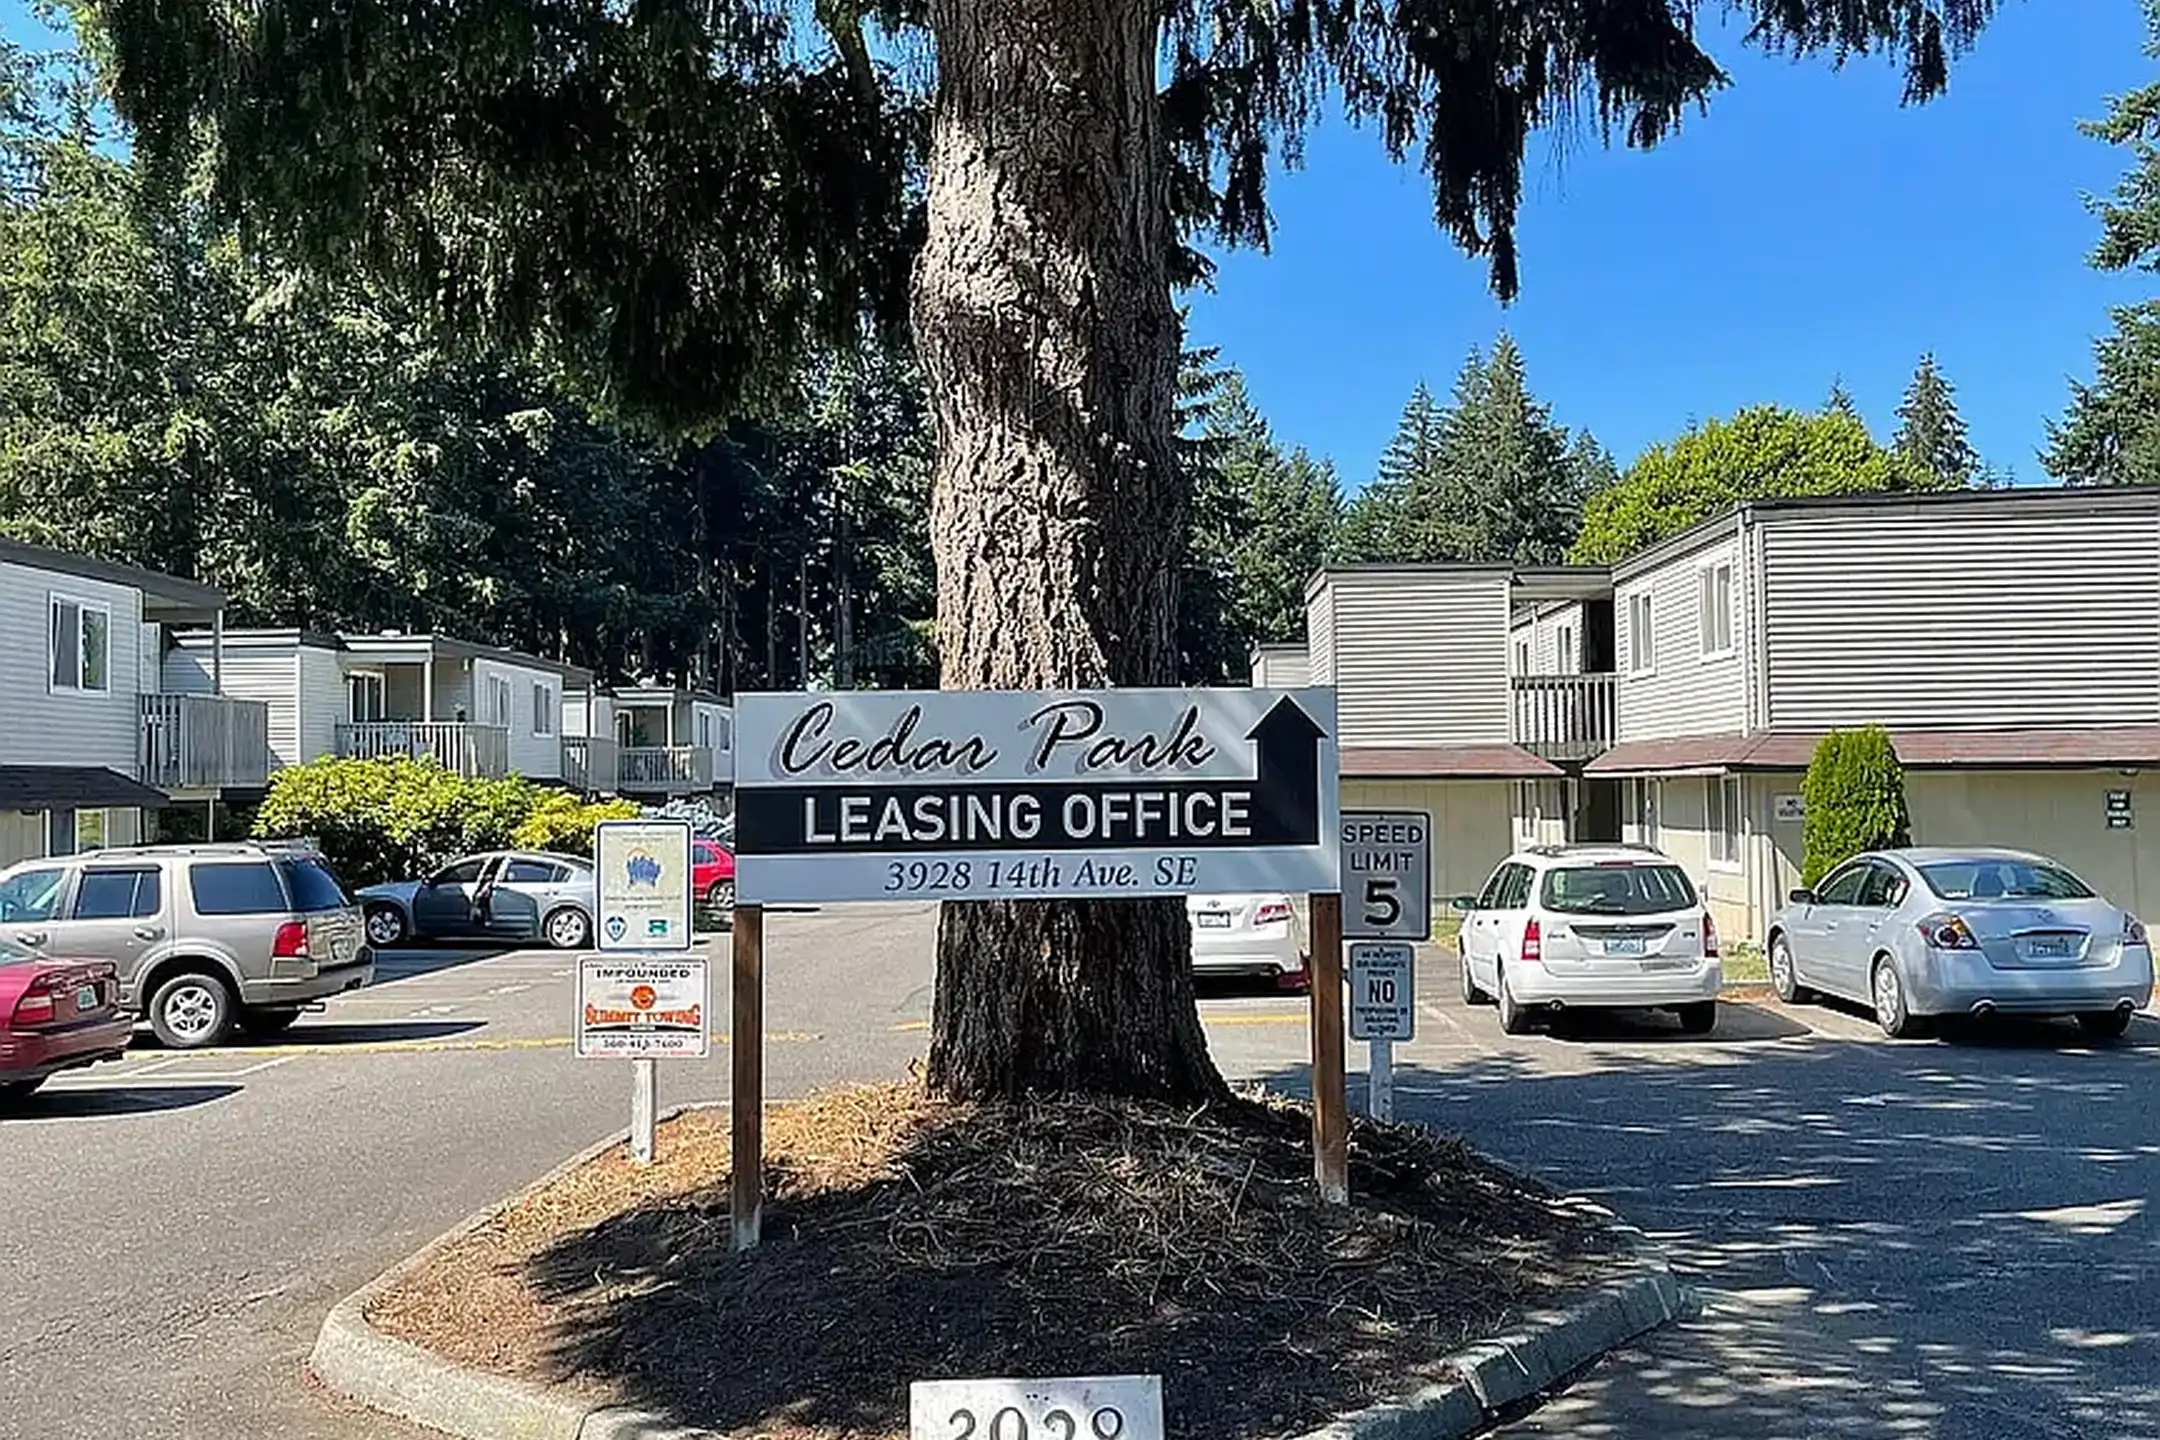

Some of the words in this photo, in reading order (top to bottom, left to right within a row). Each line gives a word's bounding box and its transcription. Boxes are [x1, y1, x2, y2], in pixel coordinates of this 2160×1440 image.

[773, 699, 998, 777] Cedar
[1021, 699, 1216, 773] Park
[805, 793, 1042, 843] LEASING
[1062, 791, 1252, 839] OFFICE
[1342, 824, 1424, 844] SPEED
[884, 860, 972, 892] 3928
[988, 857, 1061, 889] 14th
[1074, 857, 1140, 888] Ave.
[1154, 856, 1198, 887] SE
[1351, 853, 1414, 872] LIMIT
[1364, 880, 1401, 926] 5
[1368, 979, 1396, 1003] NO
